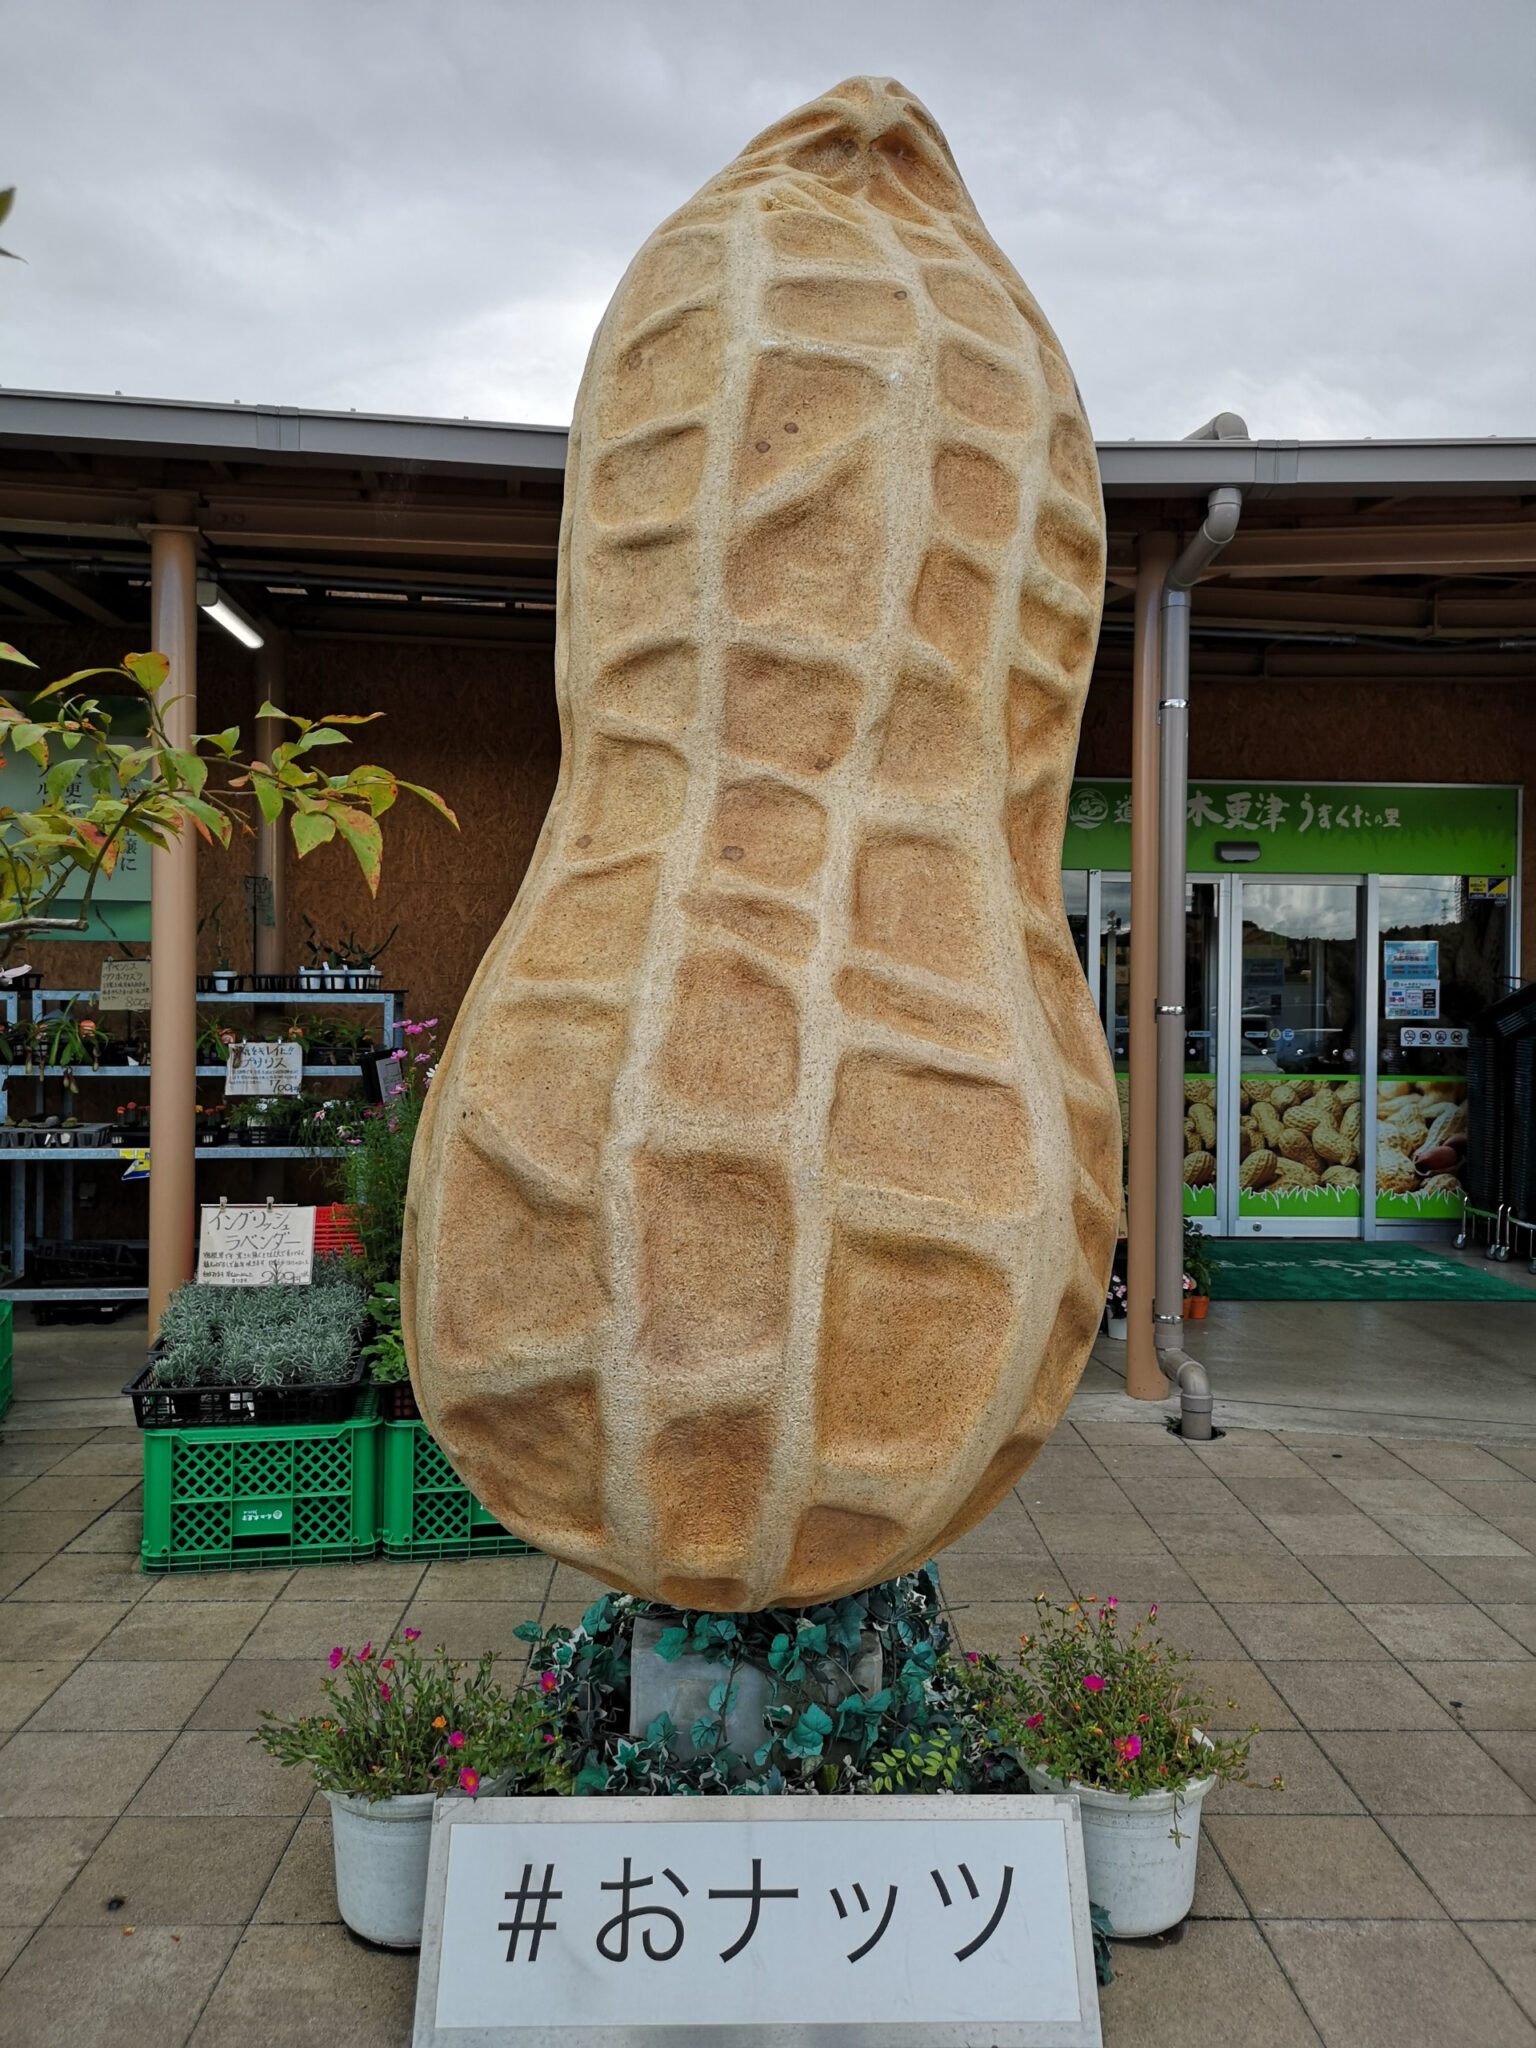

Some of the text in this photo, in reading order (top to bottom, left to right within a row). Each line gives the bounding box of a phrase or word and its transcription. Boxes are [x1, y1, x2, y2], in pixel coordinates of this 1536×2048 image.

[208, 1209, 291, 1231] イングリッシュ
[225, 1231, 301, 1251] ラベンダー
[498, 1856, 1015, 1965] #おナッツ
